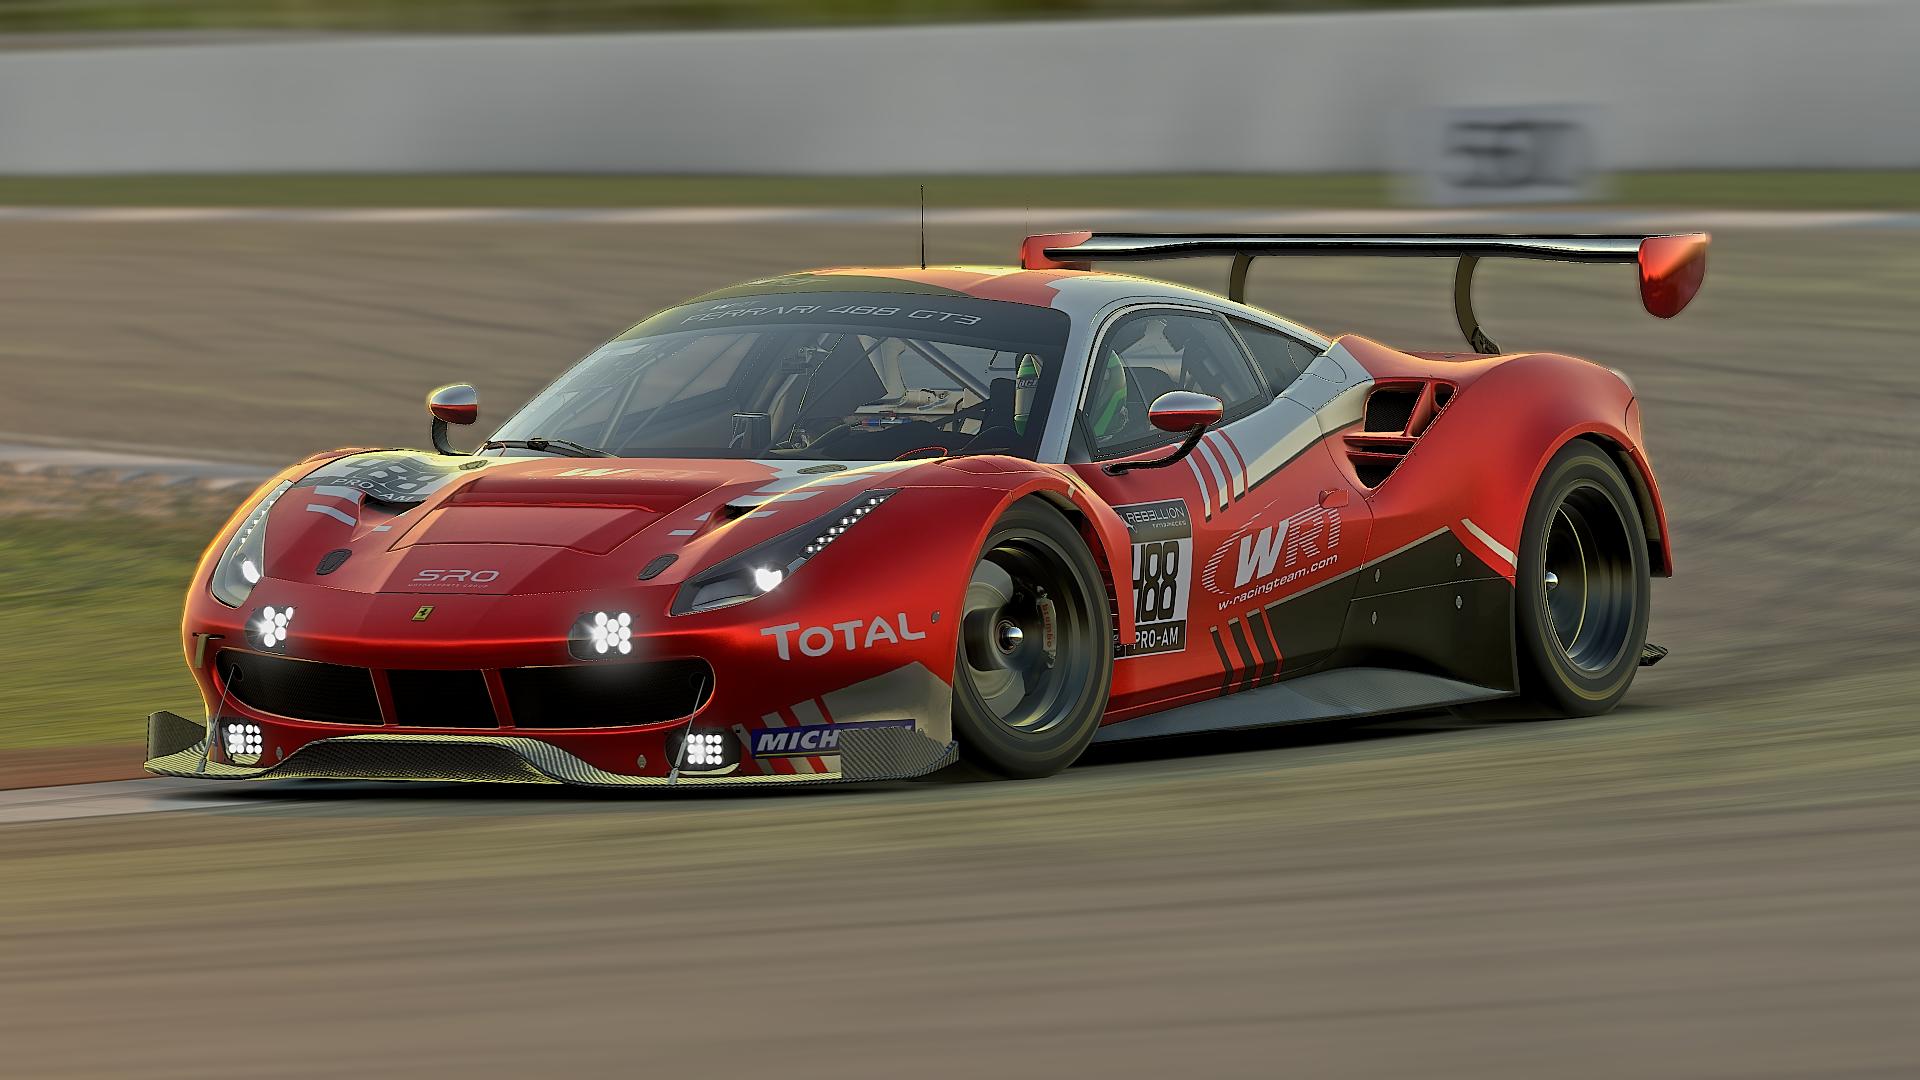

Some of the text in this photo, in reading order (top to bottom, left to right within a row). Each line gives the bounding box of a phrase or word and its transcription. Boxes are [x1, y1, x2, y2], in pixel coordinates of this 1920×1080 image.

[680, 305, 982, 325] FERRARI 488 GT3
[331, 479, 414, 500] PRO-AM
[1126, 507, 1185, 523] REBELLION
[413, 569, 500, 582] SRO
[760, 613, 926, 660] TOTAL
